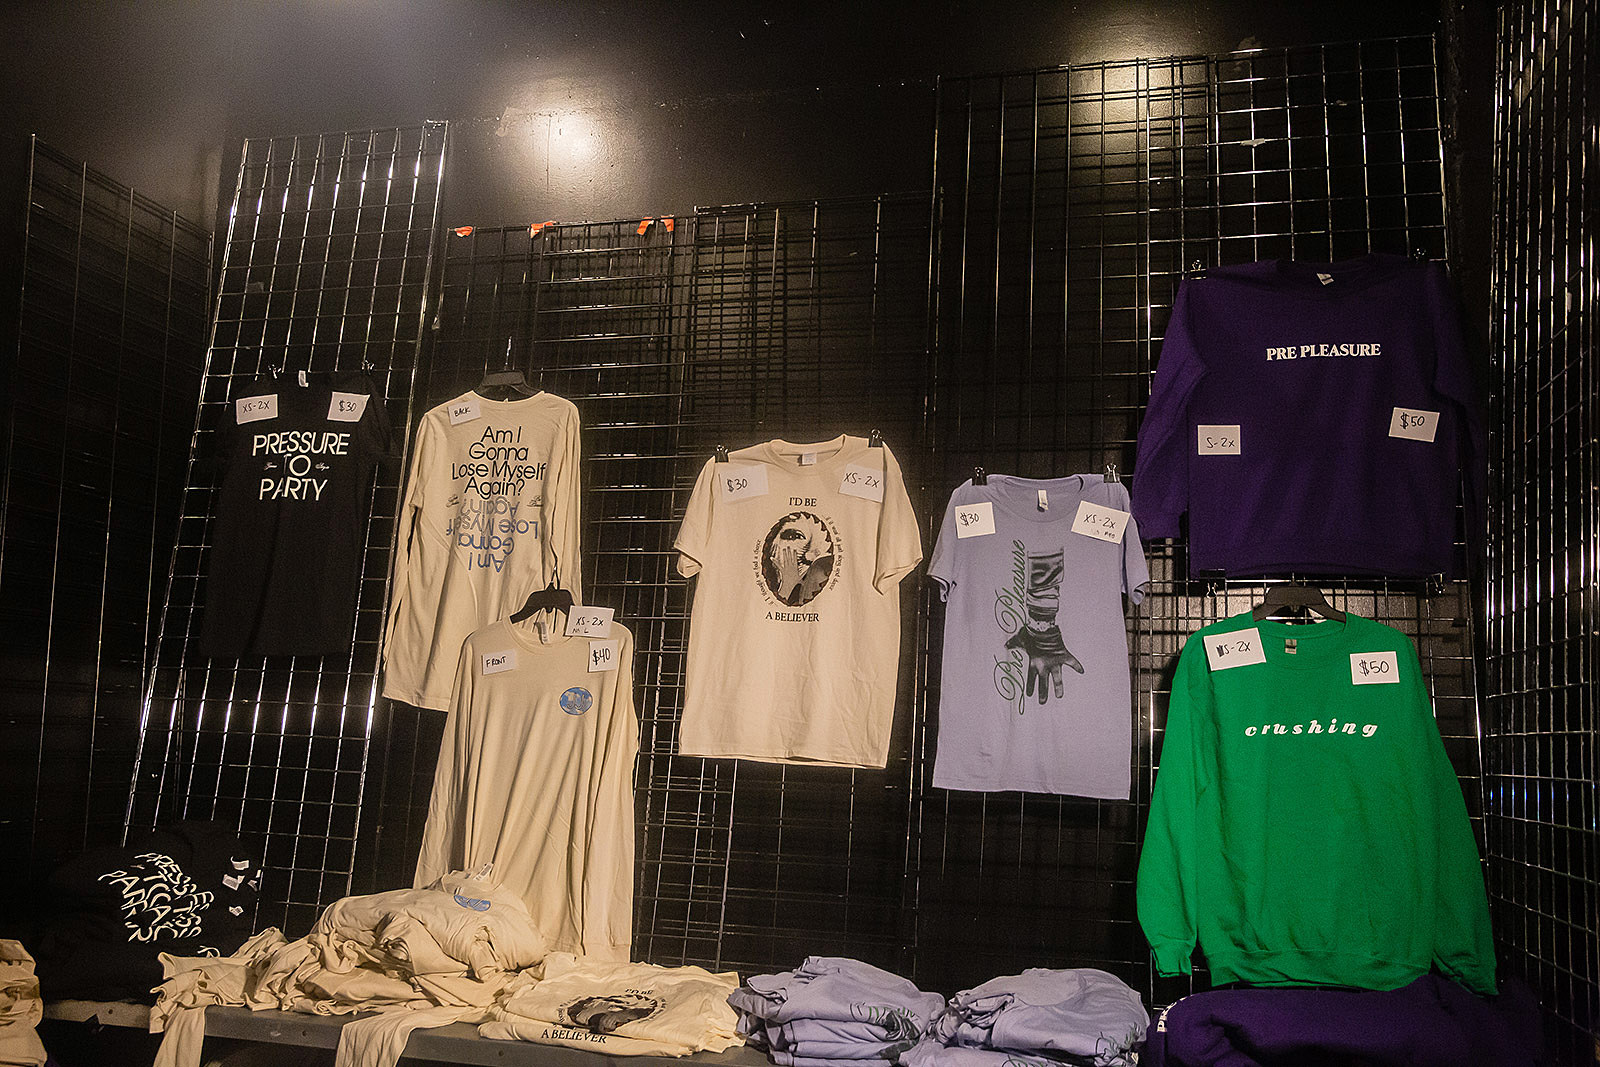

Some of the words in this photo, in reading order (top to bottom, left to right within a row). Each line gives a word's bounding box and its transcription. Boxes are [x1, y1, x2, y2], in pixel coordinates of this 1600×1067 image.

[1266, 346, 1297, 360] PRE
[1300, 344, 1381, 358] PLEASURE
[338, 400, 357, 412] $30
[454, 407, 470, 417] BACK
[1400, 412, 1425, 430] $50
[252, 431, 350, 456] PRESSURE
[480, 426, 512, 444] Am
[517, 426, 522, 444] I
[469, 442, 529, 461] Gonna
[283, 454, 311, 476] TO
[452, 462, 489, 480] Lose
[492, 460, 546, 482] Myself
[259, 477, 328, 500] PARTY
[464, 476, 526, 500] Again?
[726, 478, 748, 493] $30
[788, 497, 802, 506] I'D
[804, 498, 817, 507] BE
[960, 512, 980, 527] $30
[498, 518, 538, 540] Lose
[478, 554, 508, 572] Am
[994, 539, 1027, 634] Pleasure
[766, 611, 773, 620] A
[775, 612, 820, 622] BELIEVER
[486, 656, 506, 668] FRONT
[592, 648, 610, 666] $40
[1358, 660, 1390, 676] $50
[994, 650, 1026, 715] Pre
[1244, 718, 1378, 738] crushing
[542, 1029, 549, 1039] A
[552, 1030, 607, 1043] BELIEVER
